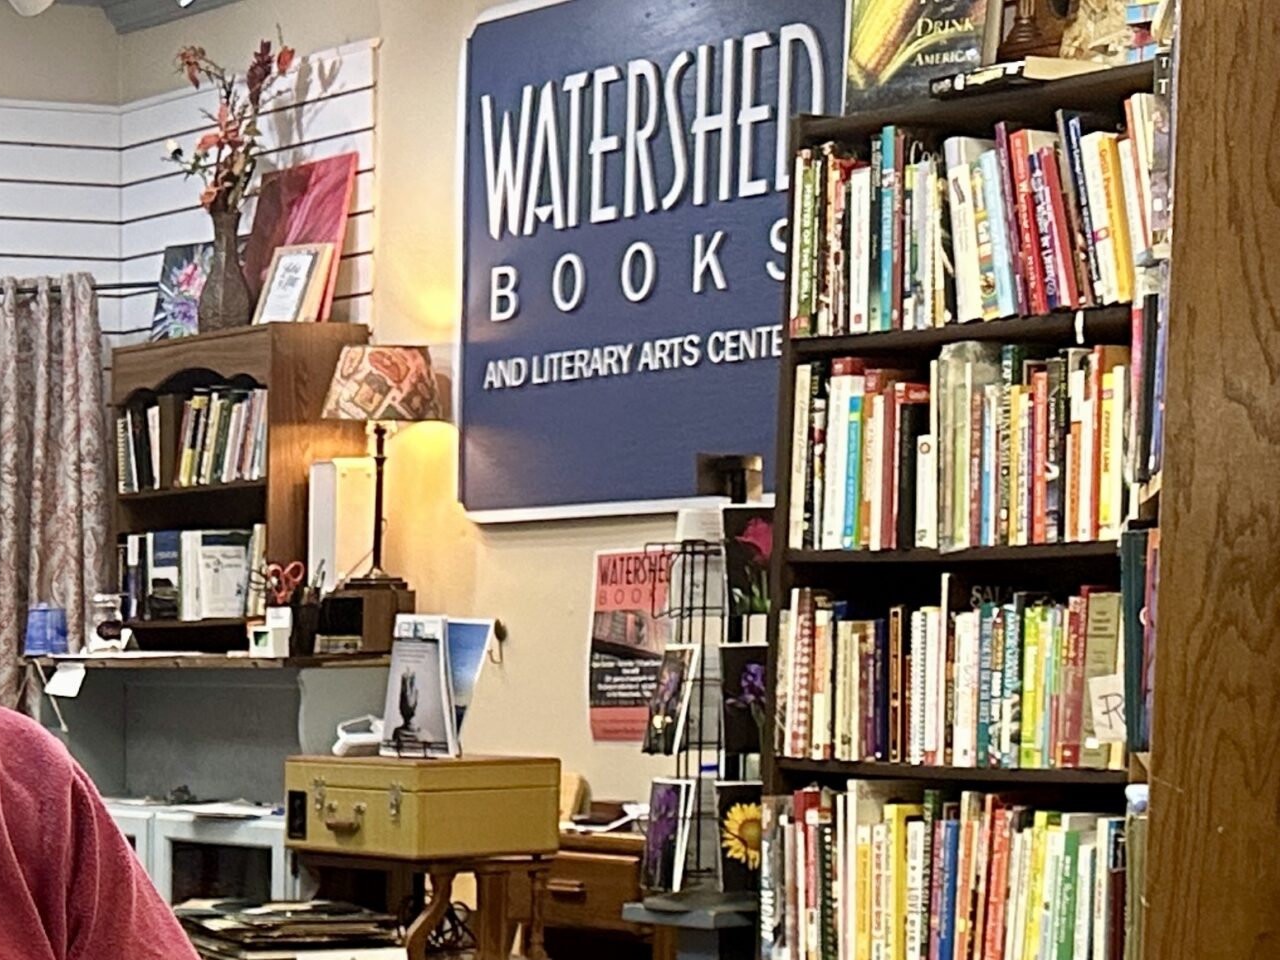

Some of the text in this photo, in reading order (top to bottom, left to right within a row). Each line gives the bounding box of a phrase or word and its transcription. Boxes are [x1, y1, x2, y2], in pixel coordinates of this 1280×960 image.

[916, 17, 974, 36] DRINK
[481, 23, 825, 240] WATERSHED
[490, 217, 788, 322] BOOKS
[483, 325, 784, 389] AND LITERARY ARTS CENTE
[599, 554, 670, 586] WATERSHE
[907, 887, 919, 914] LOVE
